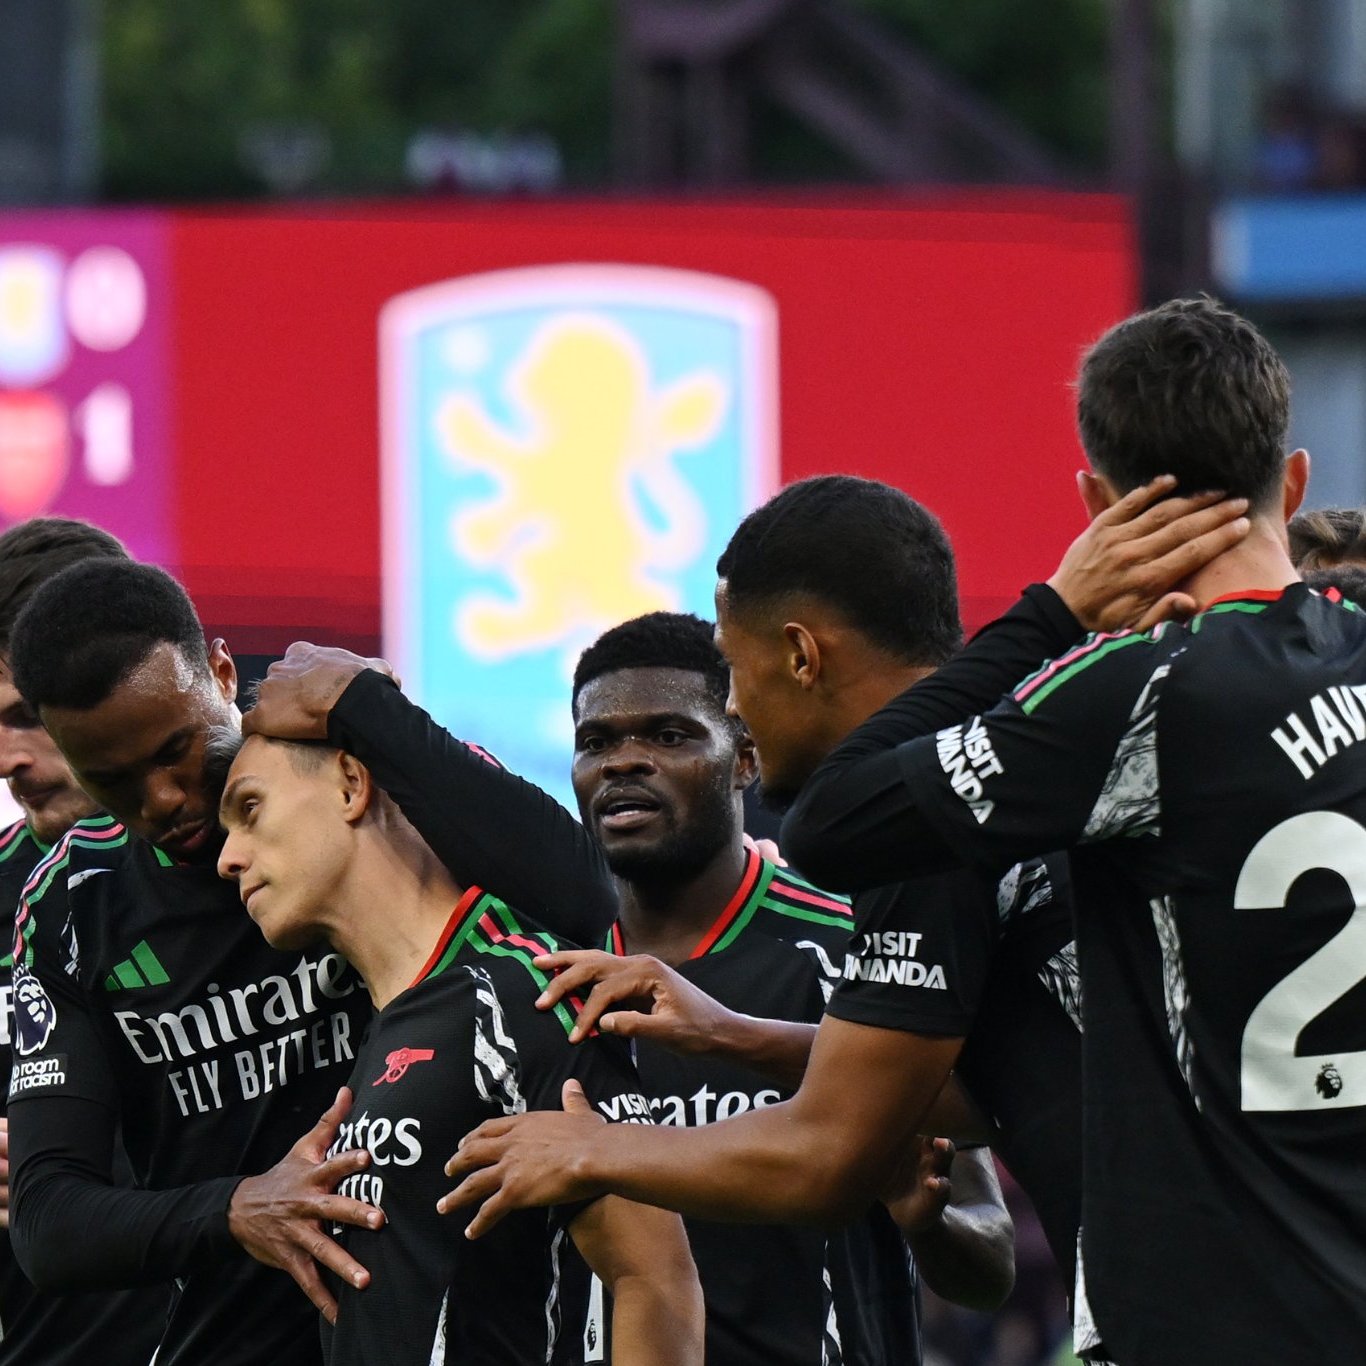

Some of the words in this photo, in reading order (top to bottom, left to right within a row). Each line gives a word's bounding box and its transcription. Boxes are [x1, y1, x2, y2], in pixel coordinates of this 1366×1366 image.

[72, 380, 133, 487] 1
[963, 715, 1004, 779] VISIT
[113, 953, 367, 1064] Emirate
[20, 1071, 65, 1090] racism
[21, 1058, 59, 1076] room
[168, 1060, 223, 1116] FLY
[235, 1011, 354, 1100] BETTER
